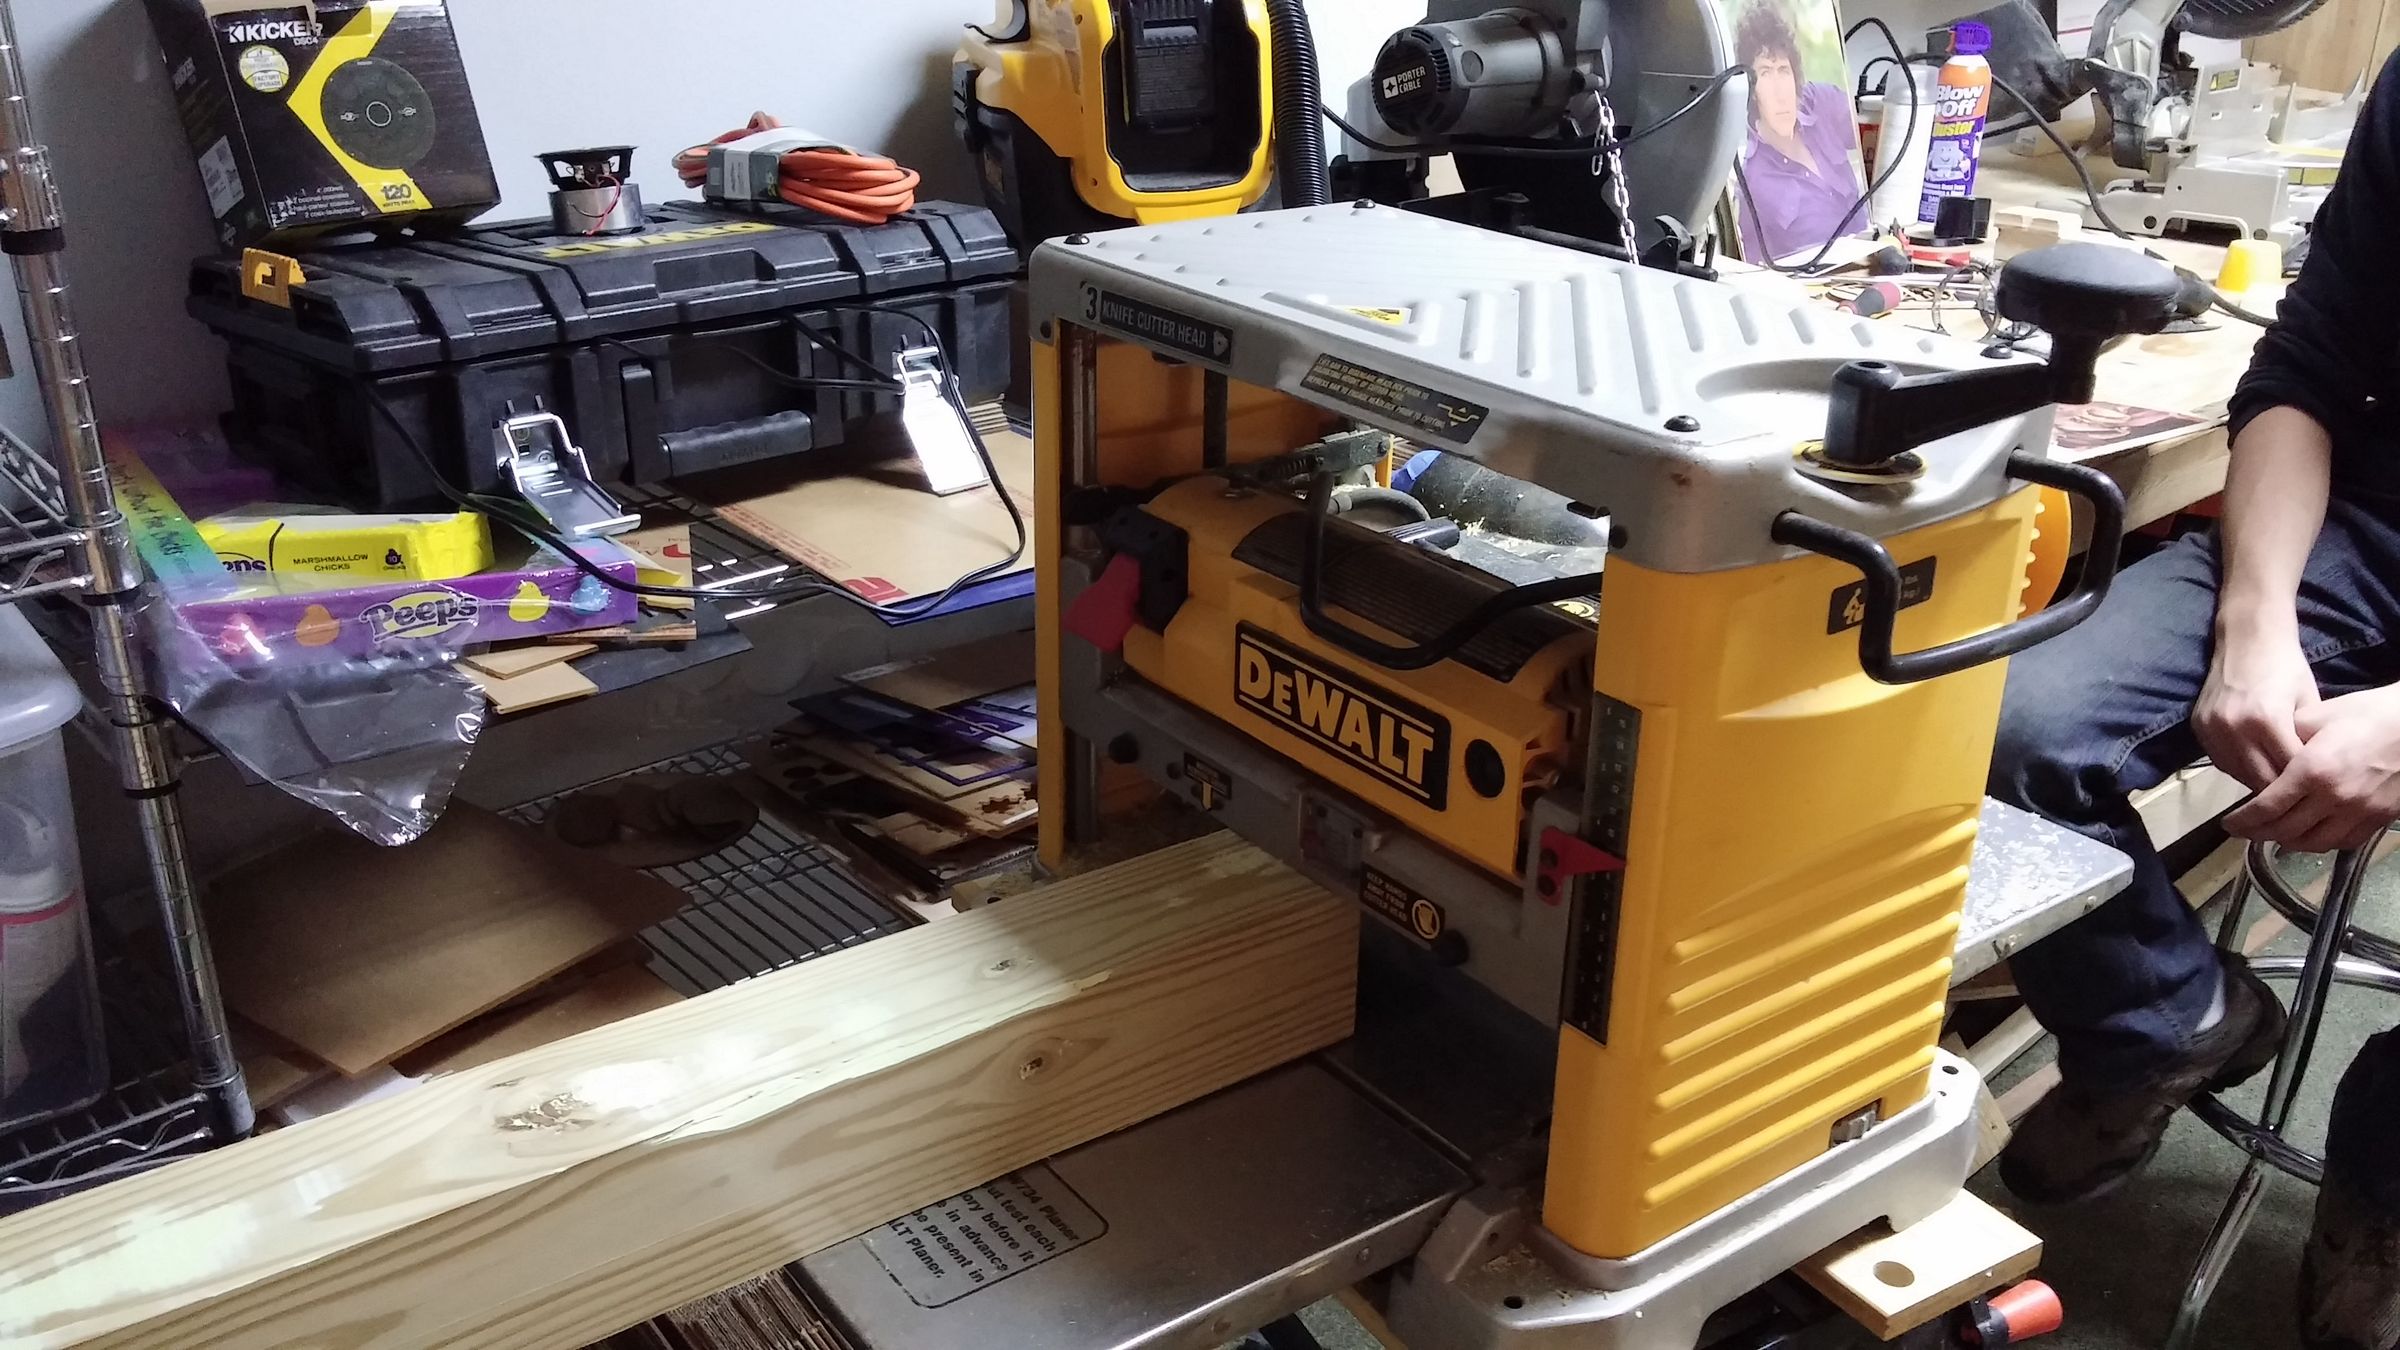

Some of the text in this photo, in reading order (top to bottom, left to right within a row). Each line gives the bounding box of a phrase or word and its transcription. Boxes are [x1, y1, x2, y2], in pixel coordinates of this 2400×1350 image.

[1397, 65, 1426, 84] PORTER
[1399, 78, 1422, 94] CABLE
[1937, 84, 1984, 101] Blow
[1941, 98, 1977, 118] Off
[381, 183, 412, 201] 120
[1085, 286, 1207, 349] 3 KNIFE CUTTER HEAD
[293, 553, 368, 565] MARSHMALLOW
[313, 563, 351, 572] CHICKS
[360, 597, 478, 642] Peeps
[945, 1208, 961, 1223] in
[958, 1224, 1008, 1272] advance
[981, 1212, 1020, 1250] before
[1018, 1250, 1035, 1263] it
[1001, 1199, 1030, 1223] test
[1024, 1223, 1057, 1252] each
[1039, 1204, 1080, 1241] Planer
[905, 1237, 946, 1279] Planer.
[923, 1224, 974, 1268] present
[968, 1268, 985, 1283] in
